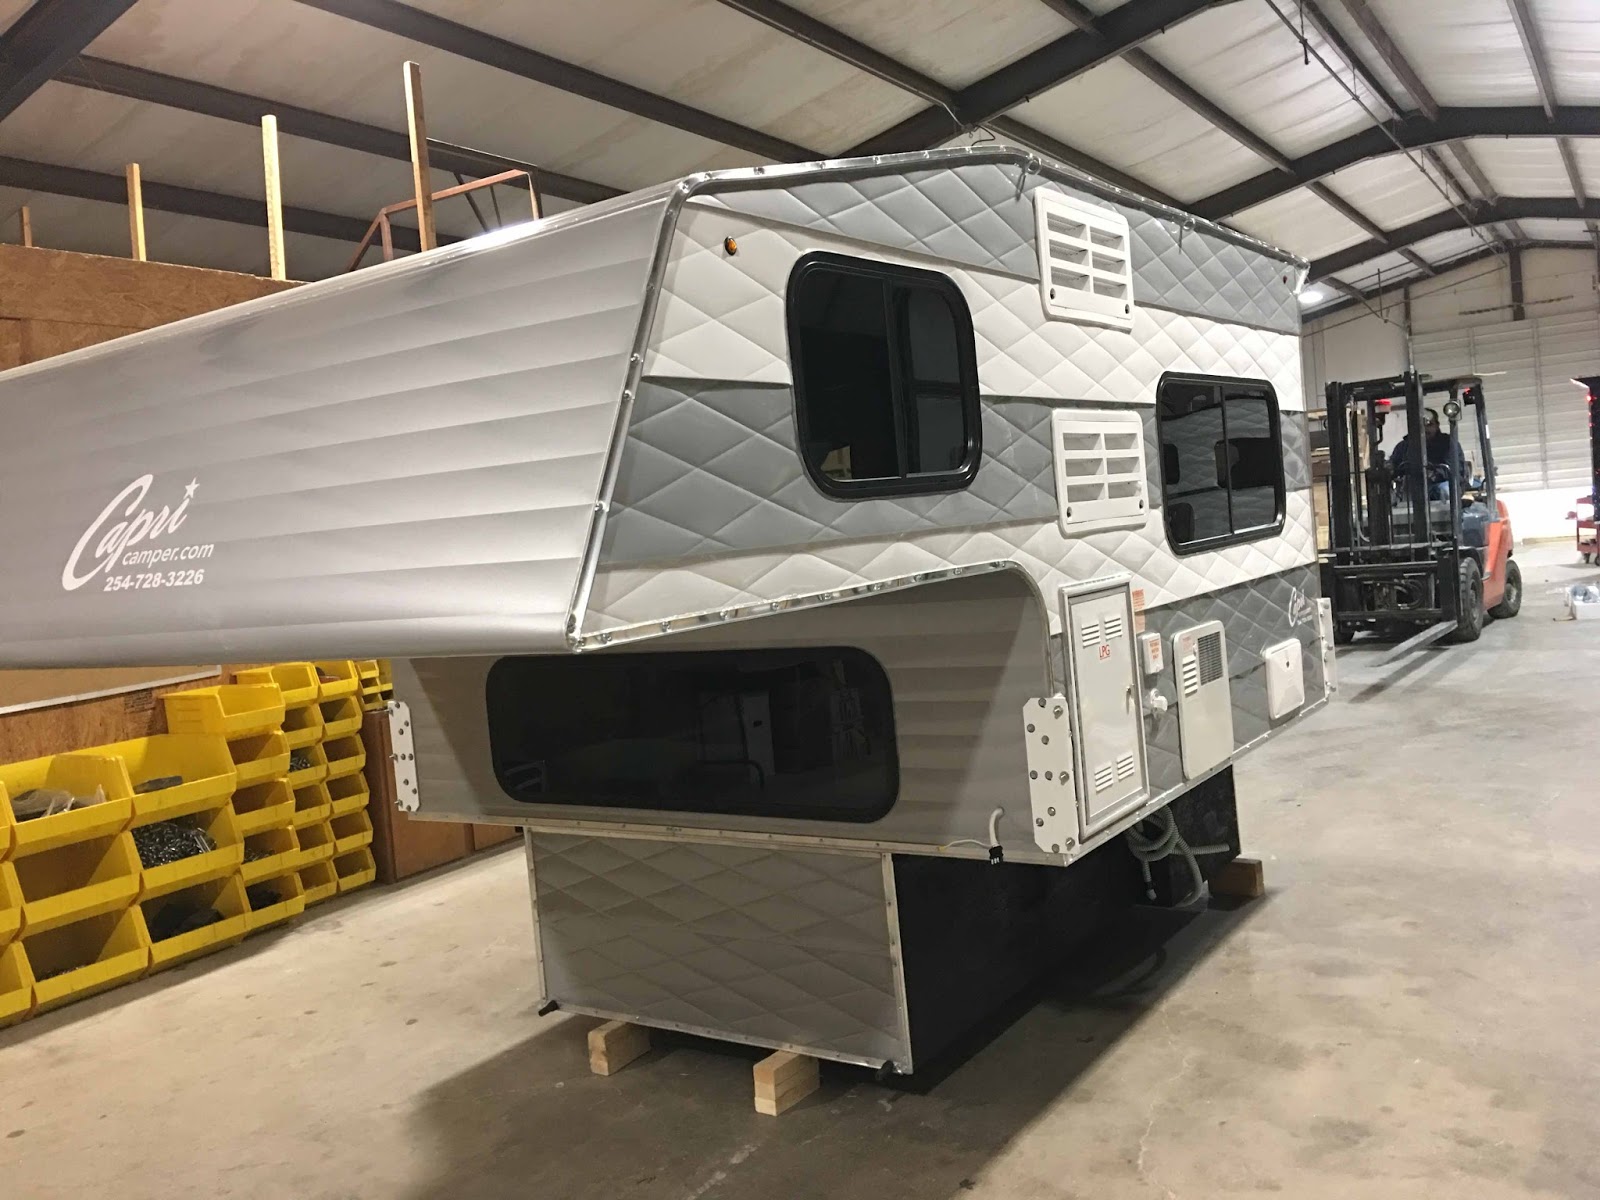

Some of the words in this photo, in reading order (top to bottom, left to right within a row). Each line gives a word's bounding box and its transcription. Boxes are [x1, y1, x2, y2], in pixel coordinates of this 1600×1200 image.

[62, 474, 199, 590] Capri
[122, 544, 214, 568] camper.com
[104, 569, 205, 591] 254-728-3226
[1099, 644, 1110, 659] LPG
